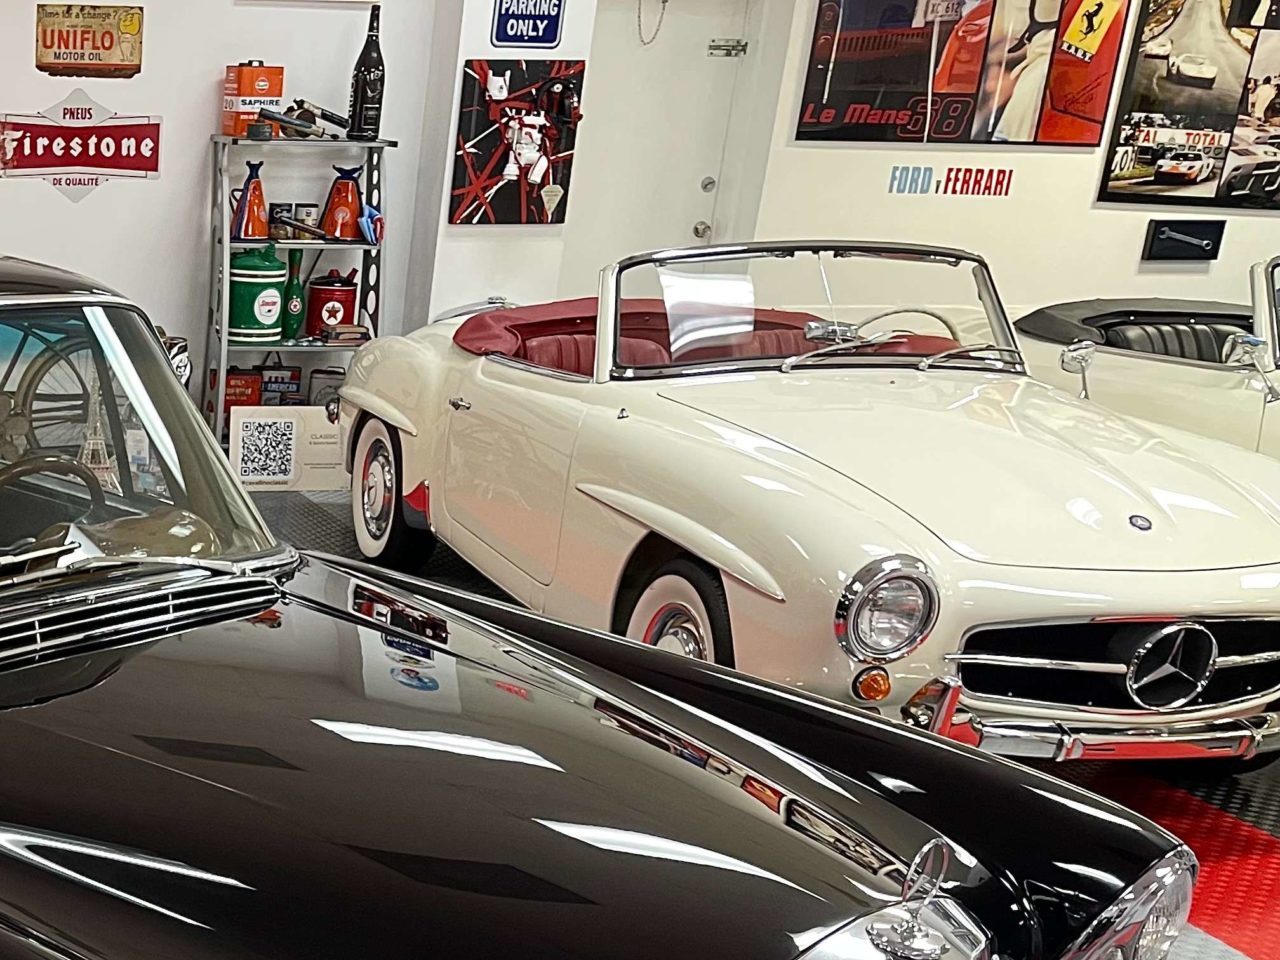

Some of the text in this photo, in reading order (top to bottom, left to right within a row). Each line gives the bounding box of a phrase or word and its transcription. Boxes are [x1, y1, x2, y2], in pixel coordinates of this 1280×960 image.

[61, 9, 73, 19] for
[501, 0, 559, 16] PARKING
[945, 2, 960, 14] 612
[506, 19, 549, 37] ONLY
[42, 28, 115, 51] UNIFLO
[53, 51, 103, 62] MOTOR OIL
[240, 98, 281, 107] SAPHIRE
[62, 107, 93, 120] PNEUS
[801, 102, 838, 124] Le
[843, 103, 913, 125] Mans
[0, 130, 155, 160] Firestone
[1185, 131, 1224, 146] TOTAL
[52, 176, 100, 188] DE QUALITÉ
[888, 165, 934, 194] FORD
[943, 167, 1014, 196] FERRARI
